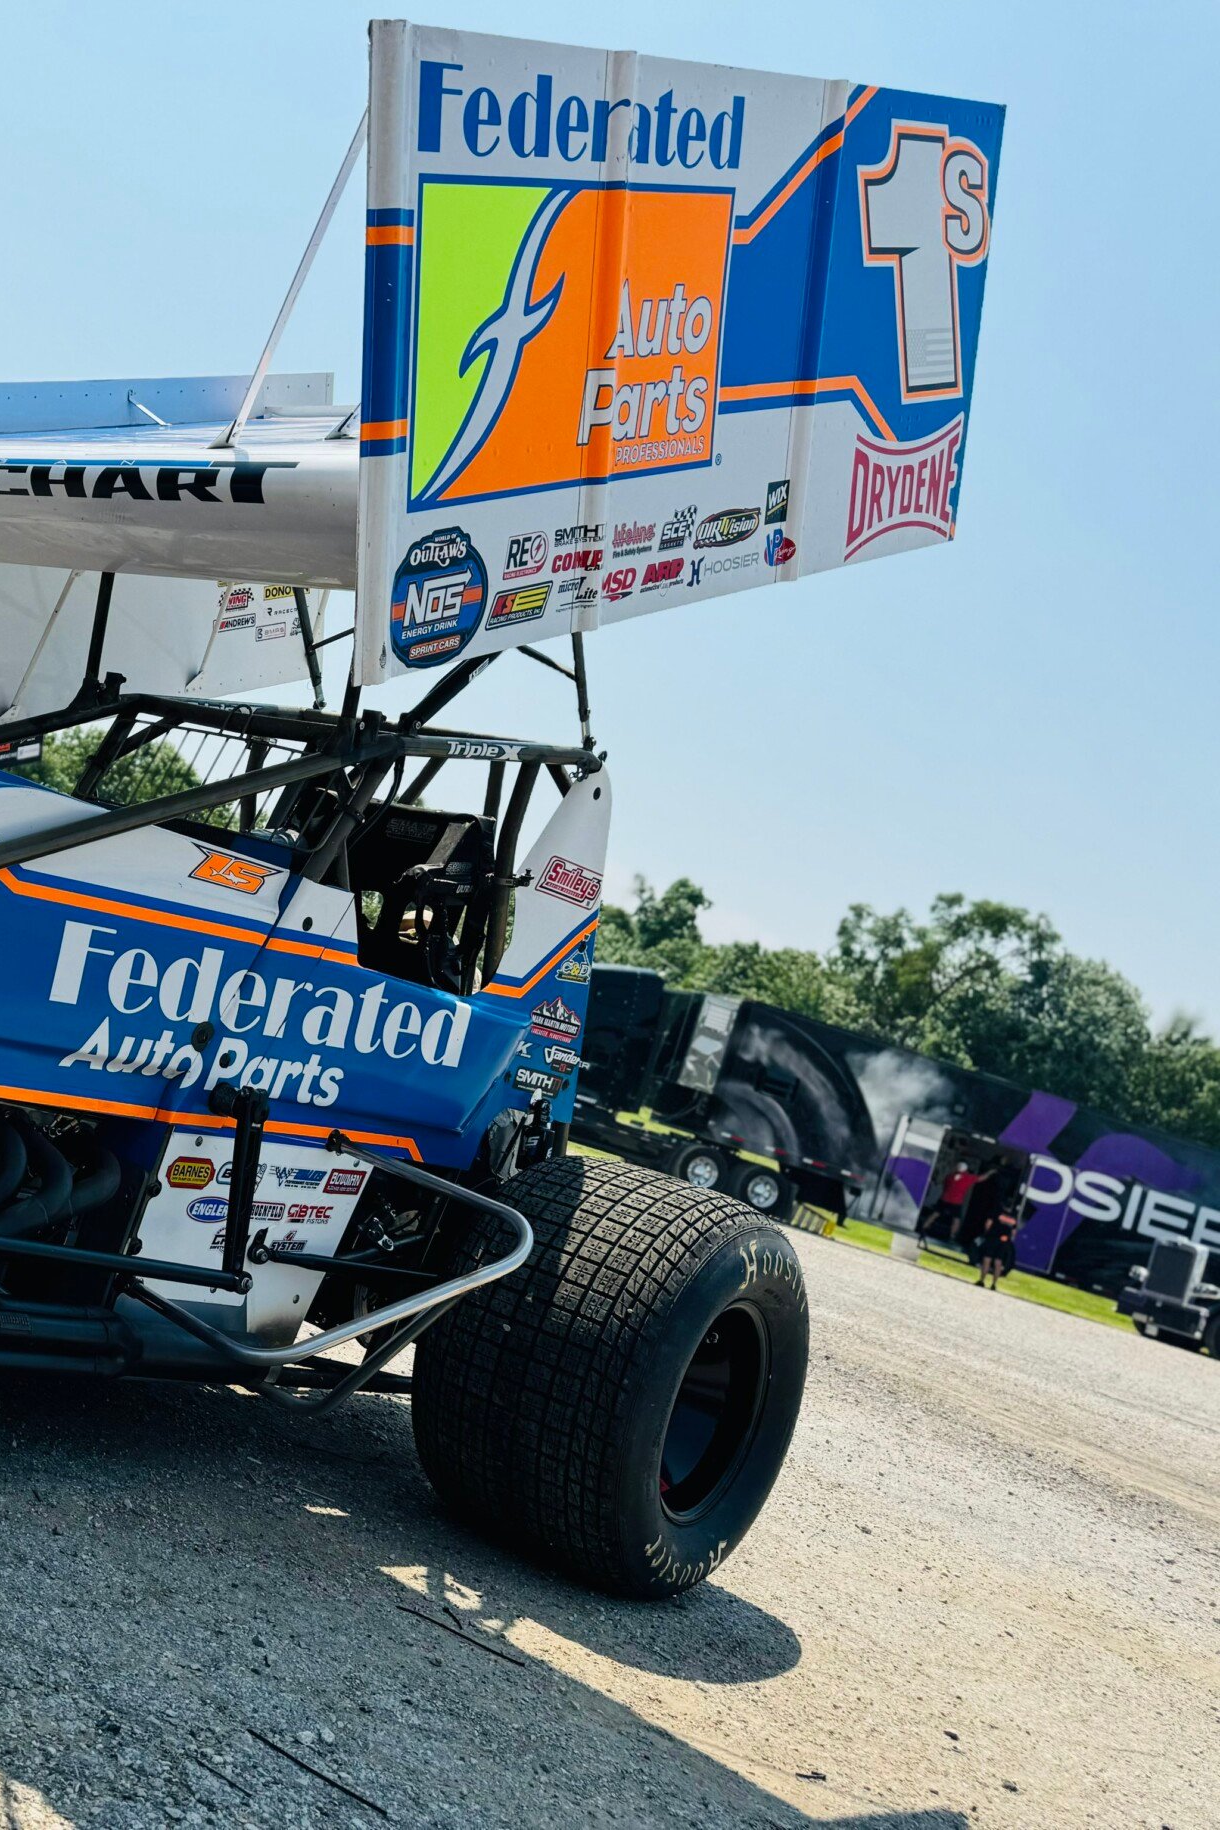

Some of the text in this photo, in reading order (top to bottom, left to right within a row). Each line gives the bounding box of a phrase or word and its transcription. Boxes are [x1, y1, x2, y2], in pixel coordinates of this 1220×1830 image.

[417, 60, 746, 170] Federated
[604, 278, 713, 360] Auto
[576, 366, 709, 446] Parts
[615, 436, 705, 466] PROFESSIONALS
[767, 482, 788, 510] WIX
[845, 431, 962, 548] DRYDENE
[662, 521, 687, 540] SCE
[641, 557, 685, 586] ARP
[703, 552, 760, 577] HOOSIER
[402, 568, 473, 629] NOS
[401, 619, 458, 640] ENERGY DRINK
[410, 637, 460, 658] SPRINT CARS
[447, 740, 499, 758] Triple
[49, 919, 473, 1068] Federated
[532, 1014, 545, 1025] MARK
[560, 1022, 579, 1034] MOTORS
[58, 1016, 346, 1108] Auto Parts
[173, 1164, 211, 1178] BARNES
[287, 1203, 334, 1219] GIBTEC
[270, 1241, 307, 1252] SYSTEM
